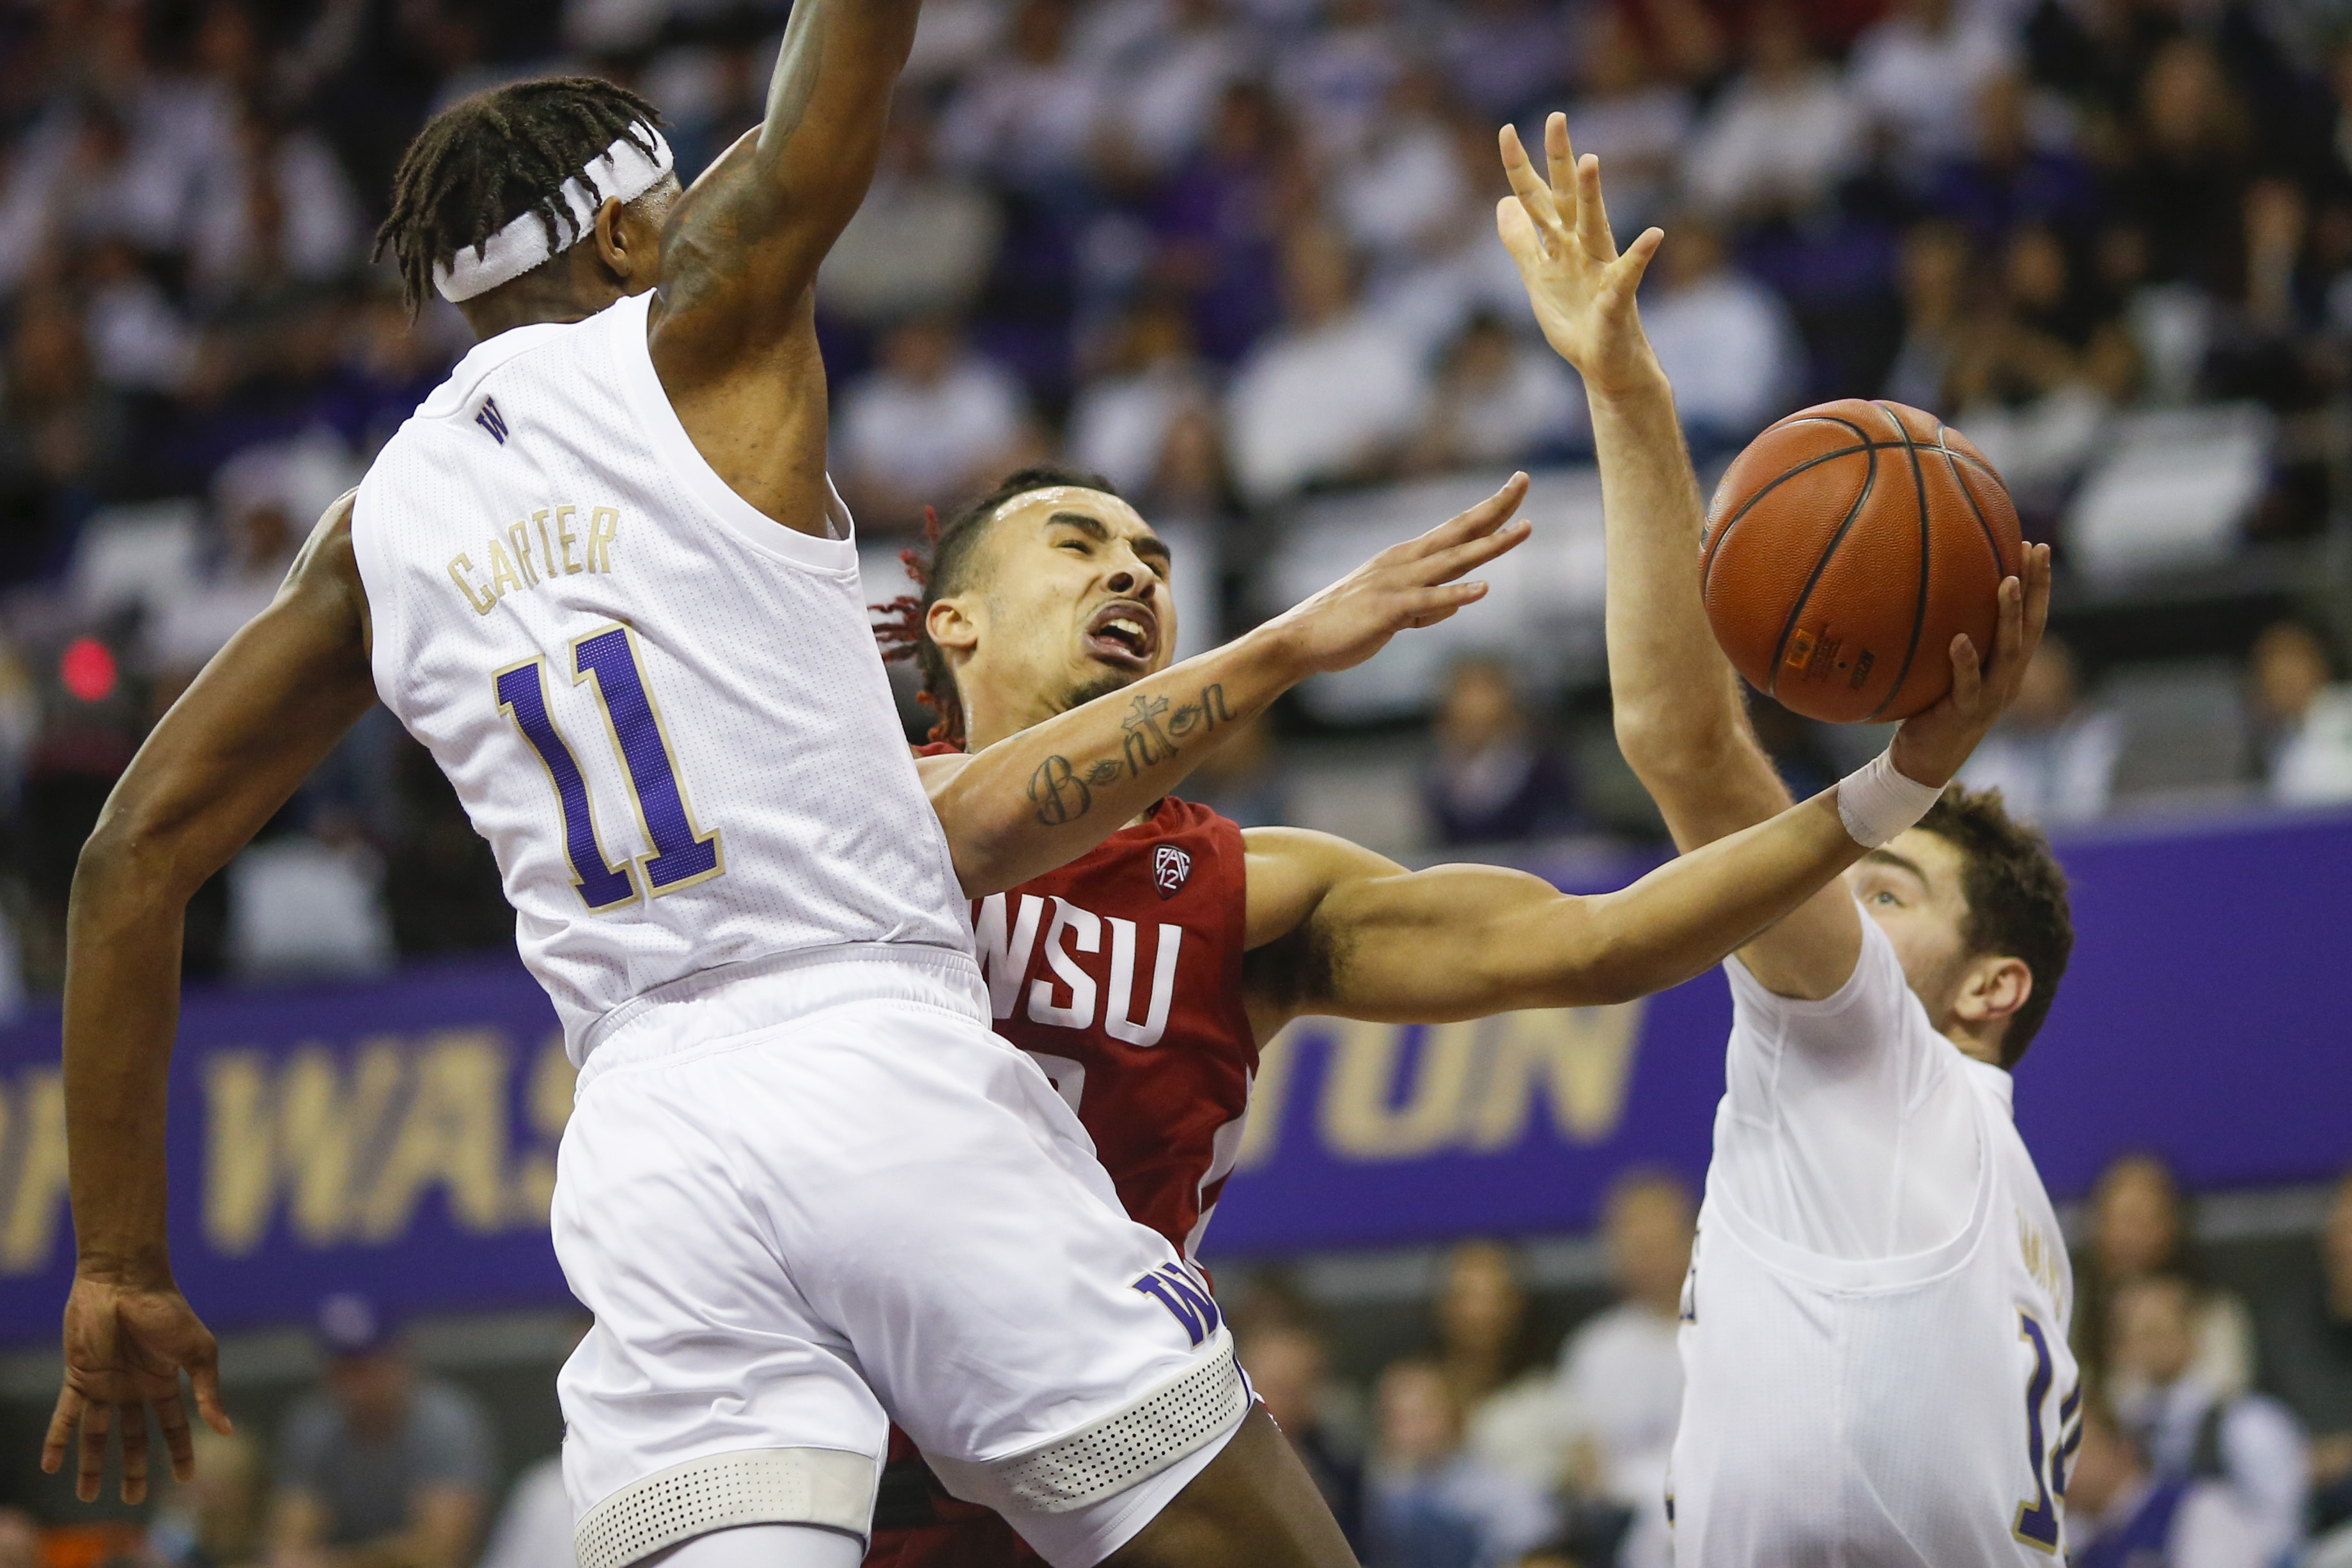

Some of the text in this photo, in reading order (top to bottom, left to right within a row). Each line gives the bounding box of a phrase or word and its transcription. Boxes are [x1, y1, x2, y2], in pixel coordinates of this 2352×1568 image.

[475, 394, 509, 447] W
[447, 505, 620, 616] CARTER
[491, 620, 726, 915] 11
[1155, 848, 1190, 881] PAC
[1158, 868, 1180, 890] 12
[974, 892, 1183, 1047] WSU
[1126, 1259, 1219, 1351] W
